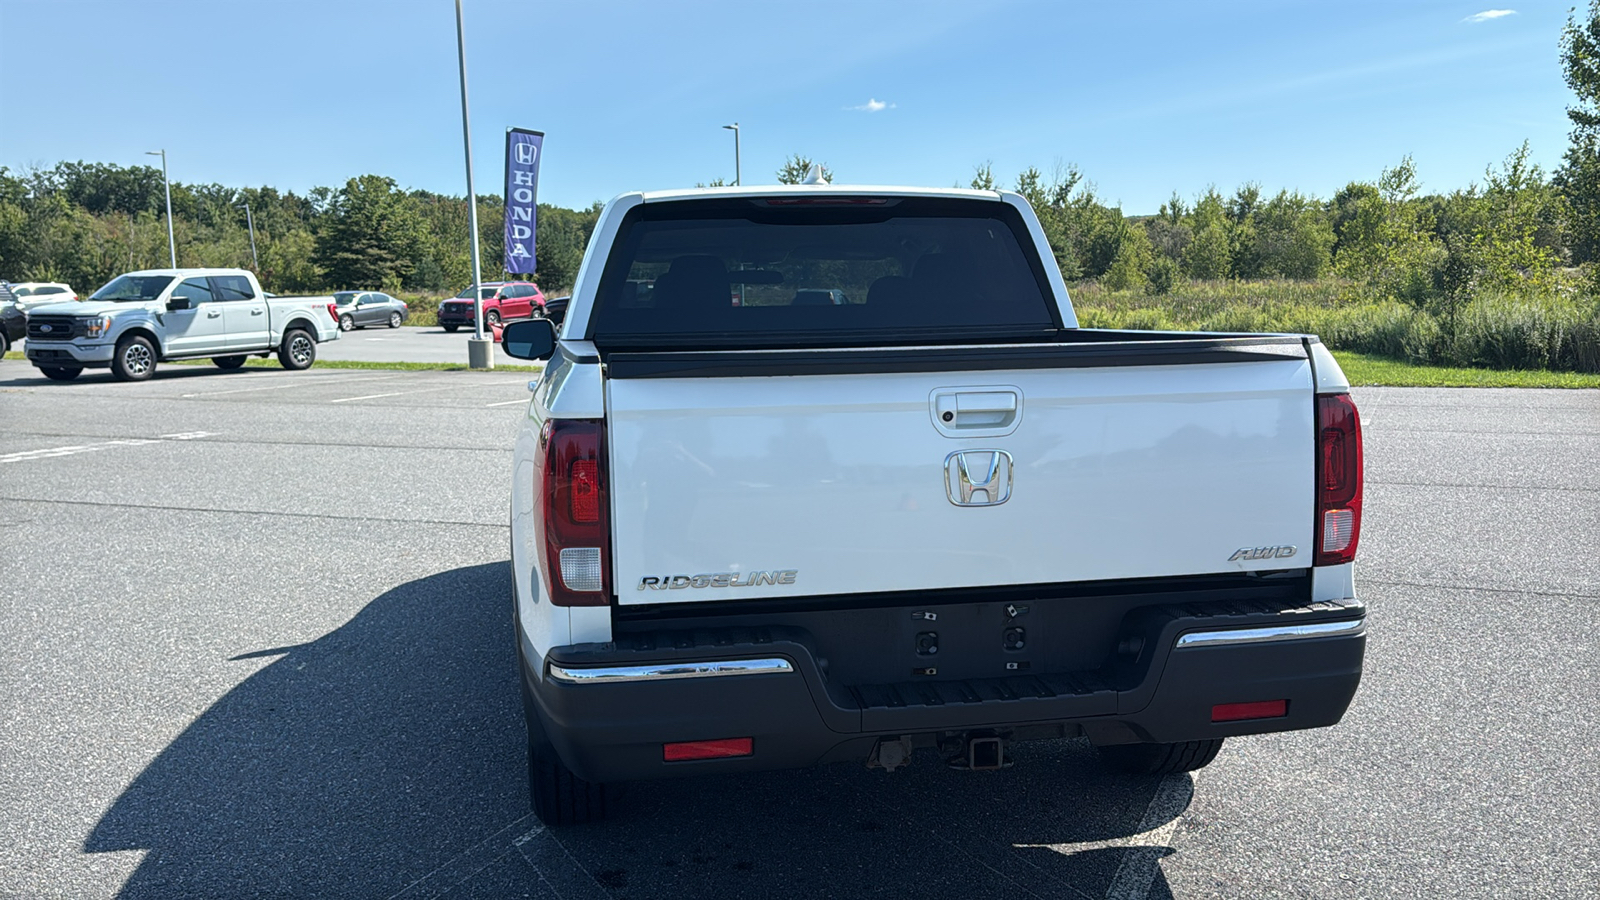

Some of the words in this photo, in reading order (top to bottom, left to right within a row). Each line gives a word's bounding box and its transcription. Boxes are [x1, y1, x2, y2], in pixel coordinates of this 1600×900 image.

[512, 170, 534, 258] HONDA
[1227, 544, 1298, 561] AWD
[637, 569, 798, 591] RIDGELINE
